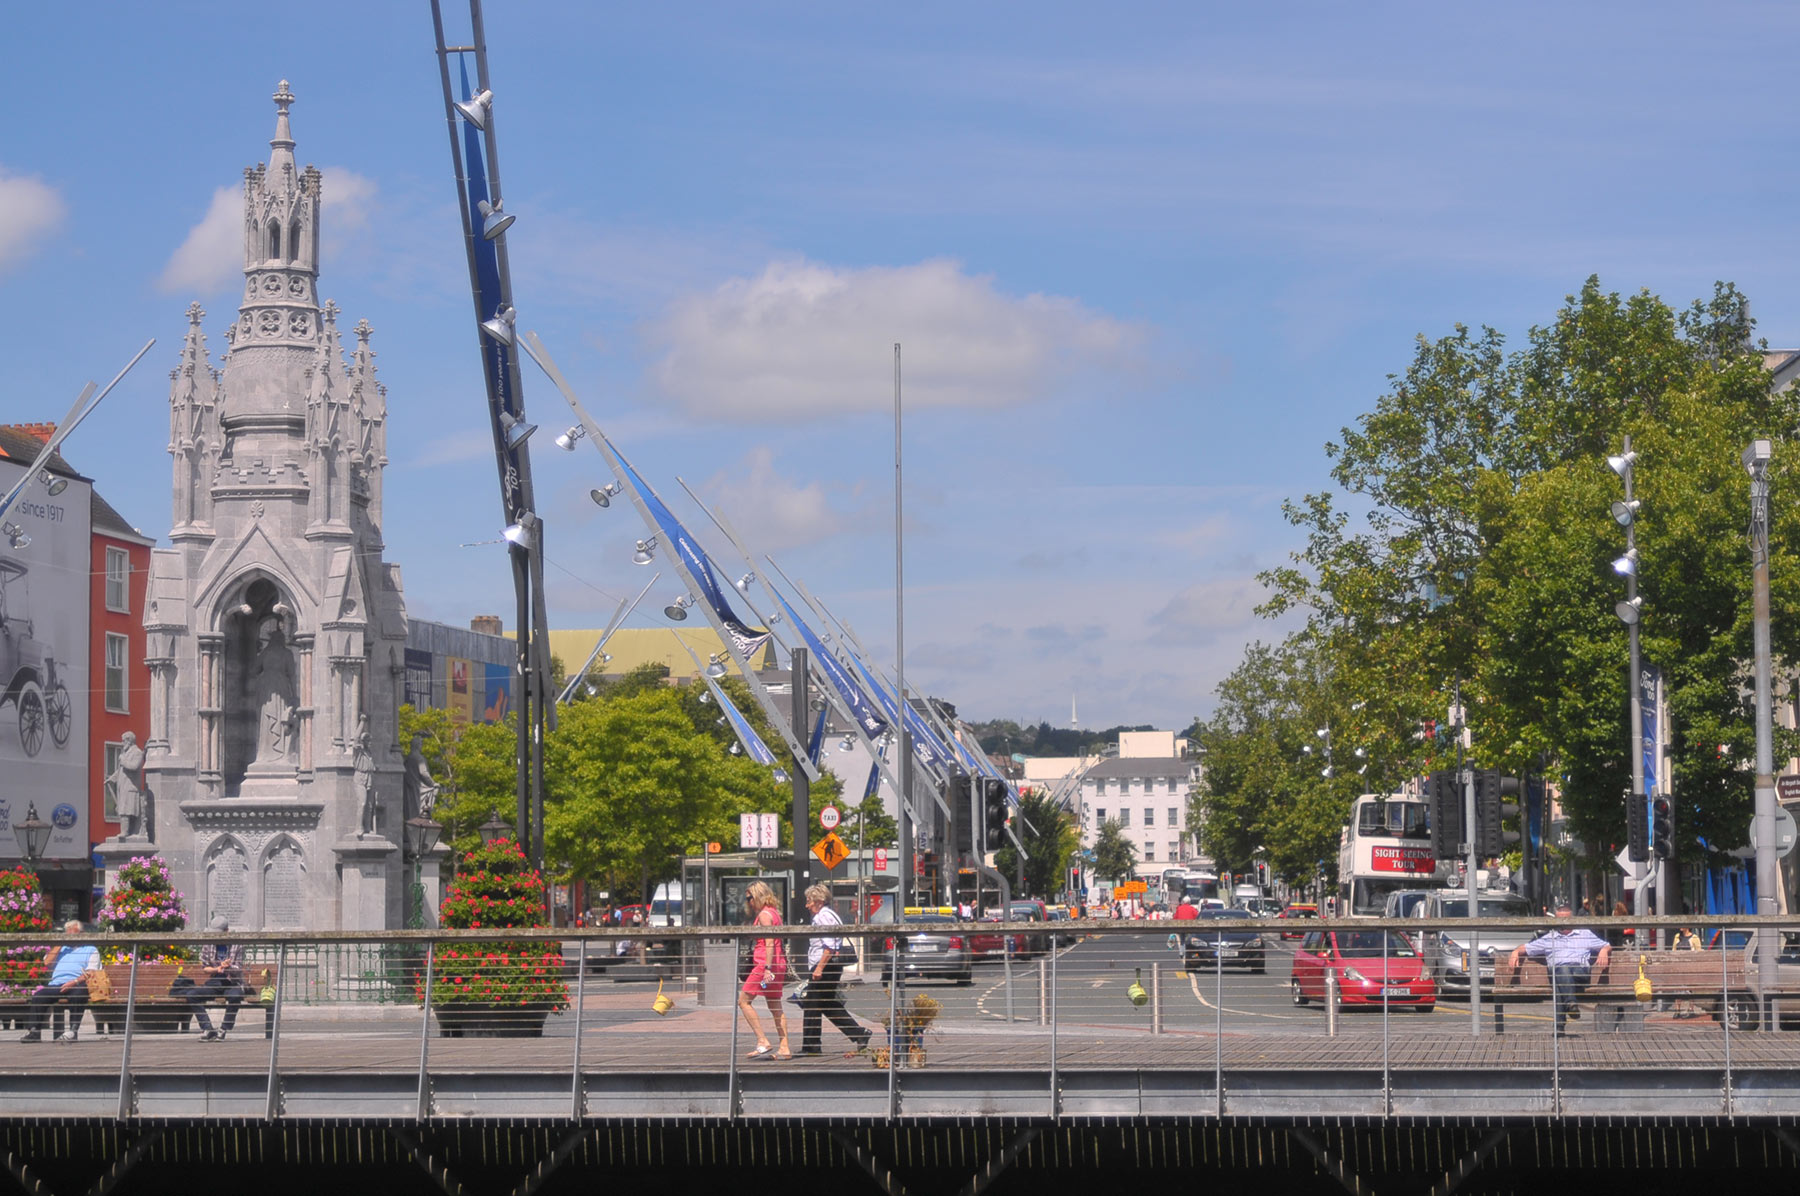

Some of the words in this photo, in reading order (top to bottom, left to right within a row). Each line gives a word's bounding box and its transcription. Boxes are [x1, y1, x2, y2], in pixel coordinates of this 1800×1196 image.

[510, 466, 519, 490] 100
[22, 499, 45, 518] since
[46, 504, 64, 522] 1917
[1640, 670, 1655, 690] Ford
[1375, 849, 1400, 858] SIGHT
[1403, 850, 1432, 859] SEEING
[1392, 859, 1415, 869] TOUR
